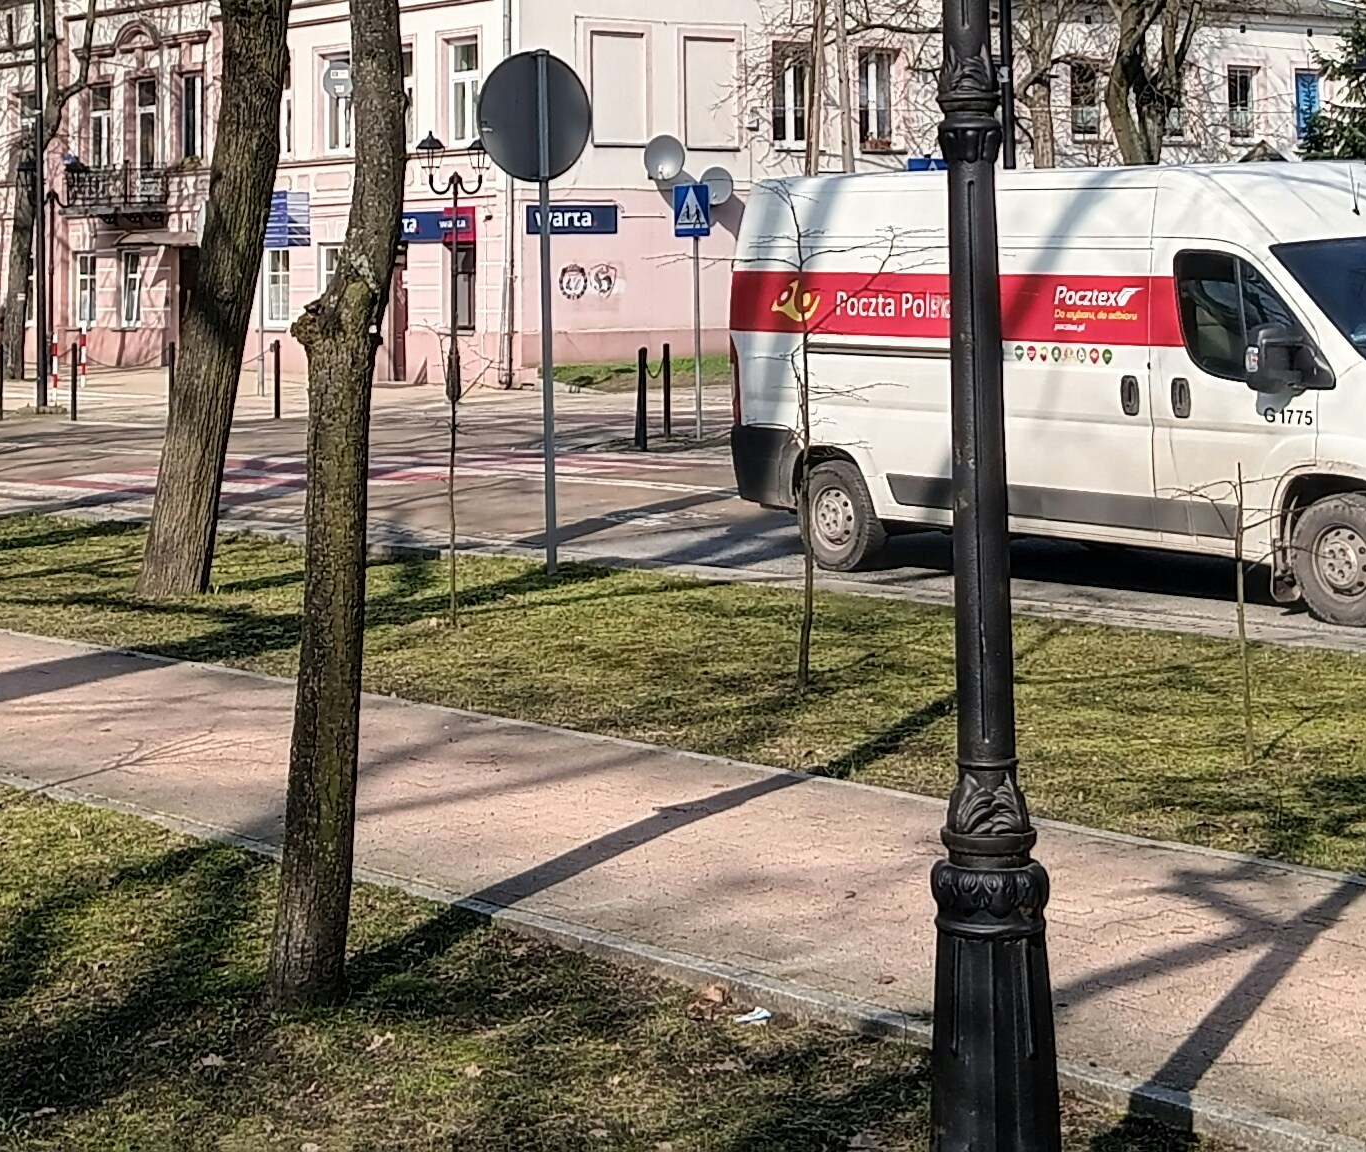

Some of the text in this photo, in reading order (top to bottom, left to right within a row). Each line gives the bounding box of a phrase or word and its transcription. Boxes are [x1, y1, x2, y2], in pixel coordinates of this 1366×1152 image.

[835, 290, 895, 317] Poczta
[1054, 285, 1117, 307] Pocztex
[1263, 406, 1313, 426] G 1775
